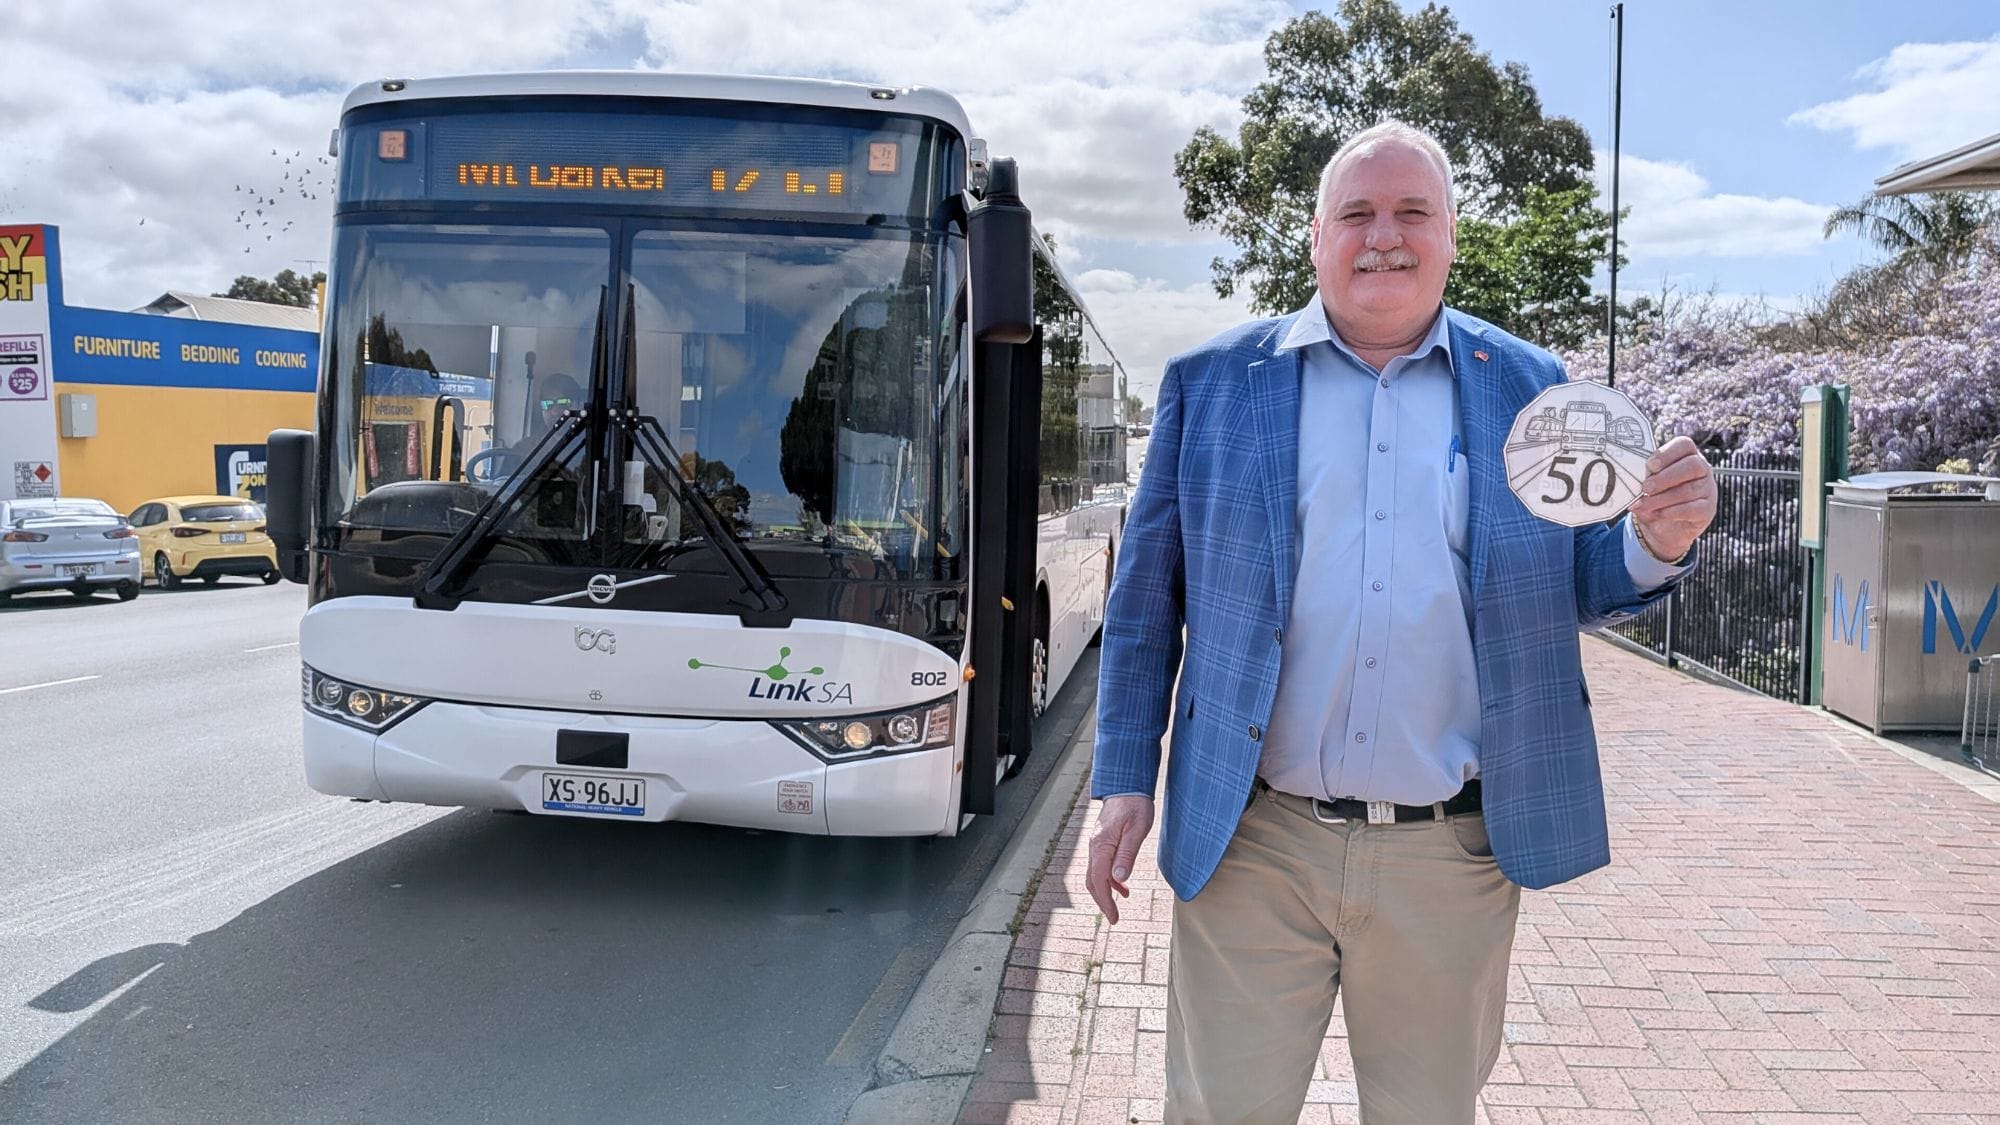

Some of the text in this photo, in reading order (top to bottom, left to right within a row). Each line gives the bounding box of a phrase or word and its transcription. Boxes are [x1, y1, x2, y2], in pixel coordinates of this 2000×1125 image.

[74, 335, 307, 369] FURNITURE BEDDING COOKING
[12, 378, 33, 390] $25
[1541, 456, 1616, 506] 50
[911, 671, 947, 686] 802
